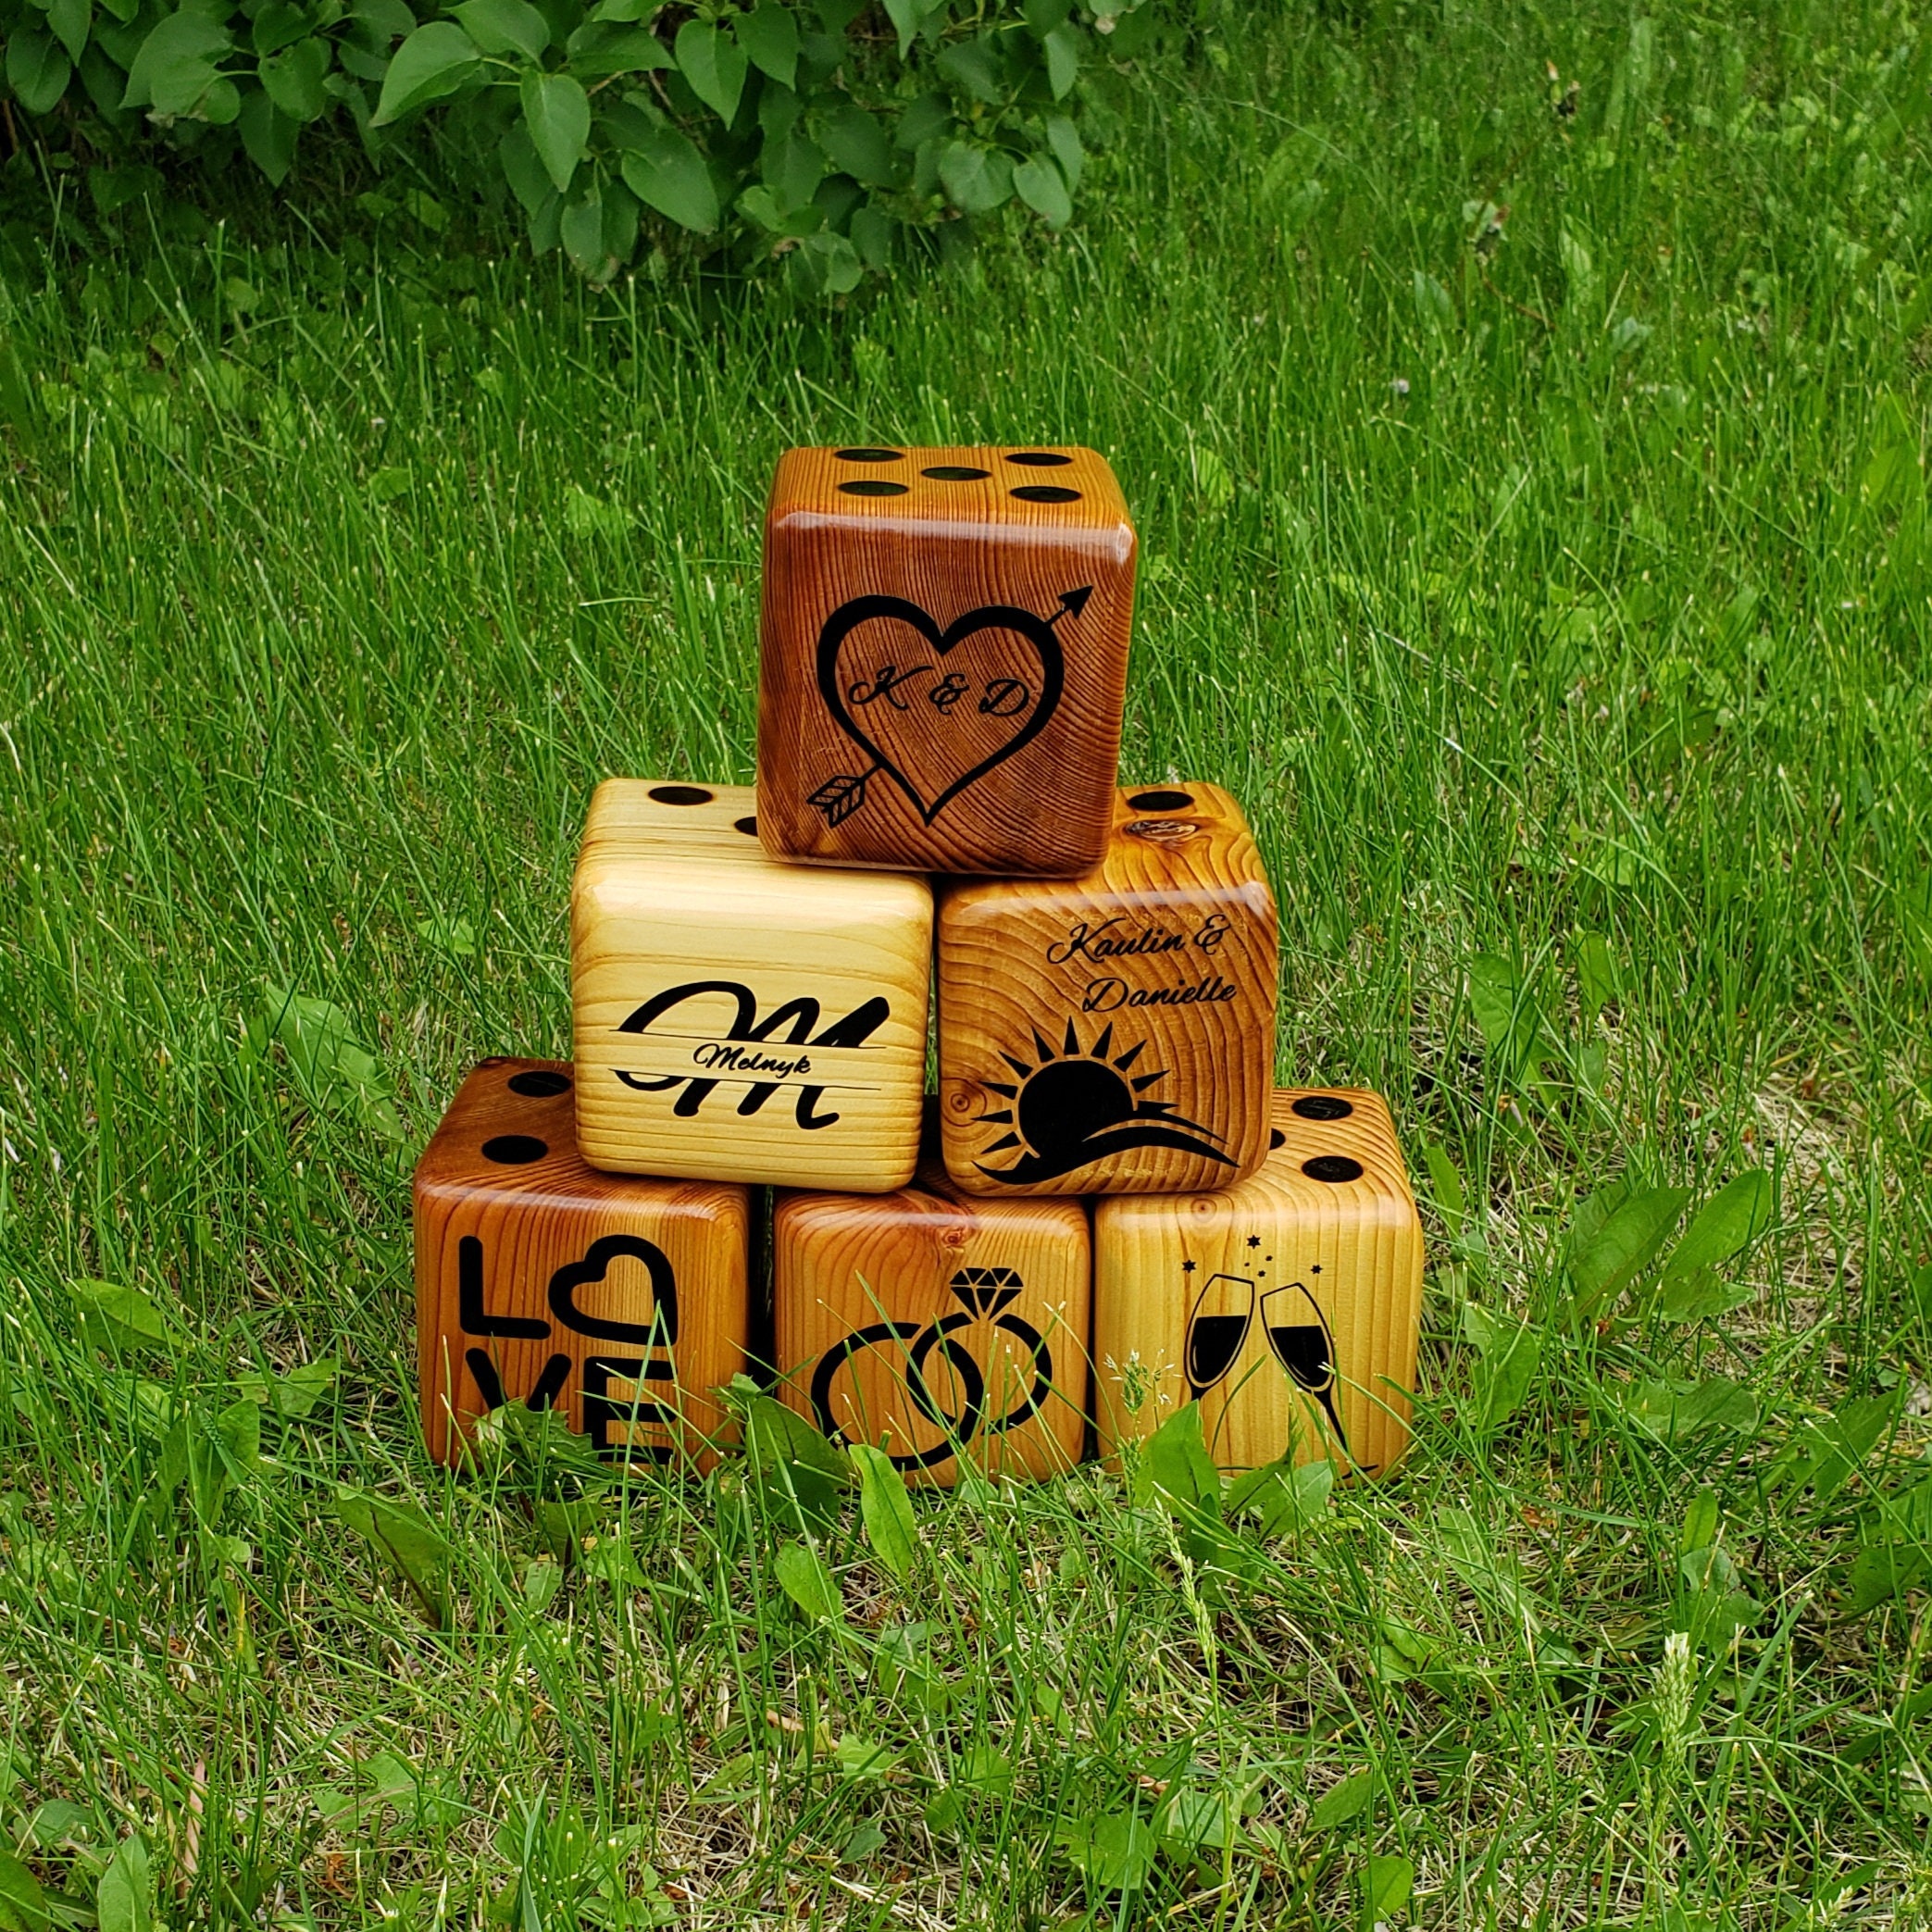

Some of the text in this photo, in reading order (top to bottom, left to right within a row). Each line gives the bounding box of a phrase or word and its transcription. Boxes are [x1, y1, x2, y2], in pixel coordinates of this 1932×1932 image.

[848, 666, 1029, 717] K & D
[1046, 914, 1231, 965] Kaulin &
[1082, 977, 1237, 1013] Danielle
[692, 1043, 811, 1078] Melnyk
